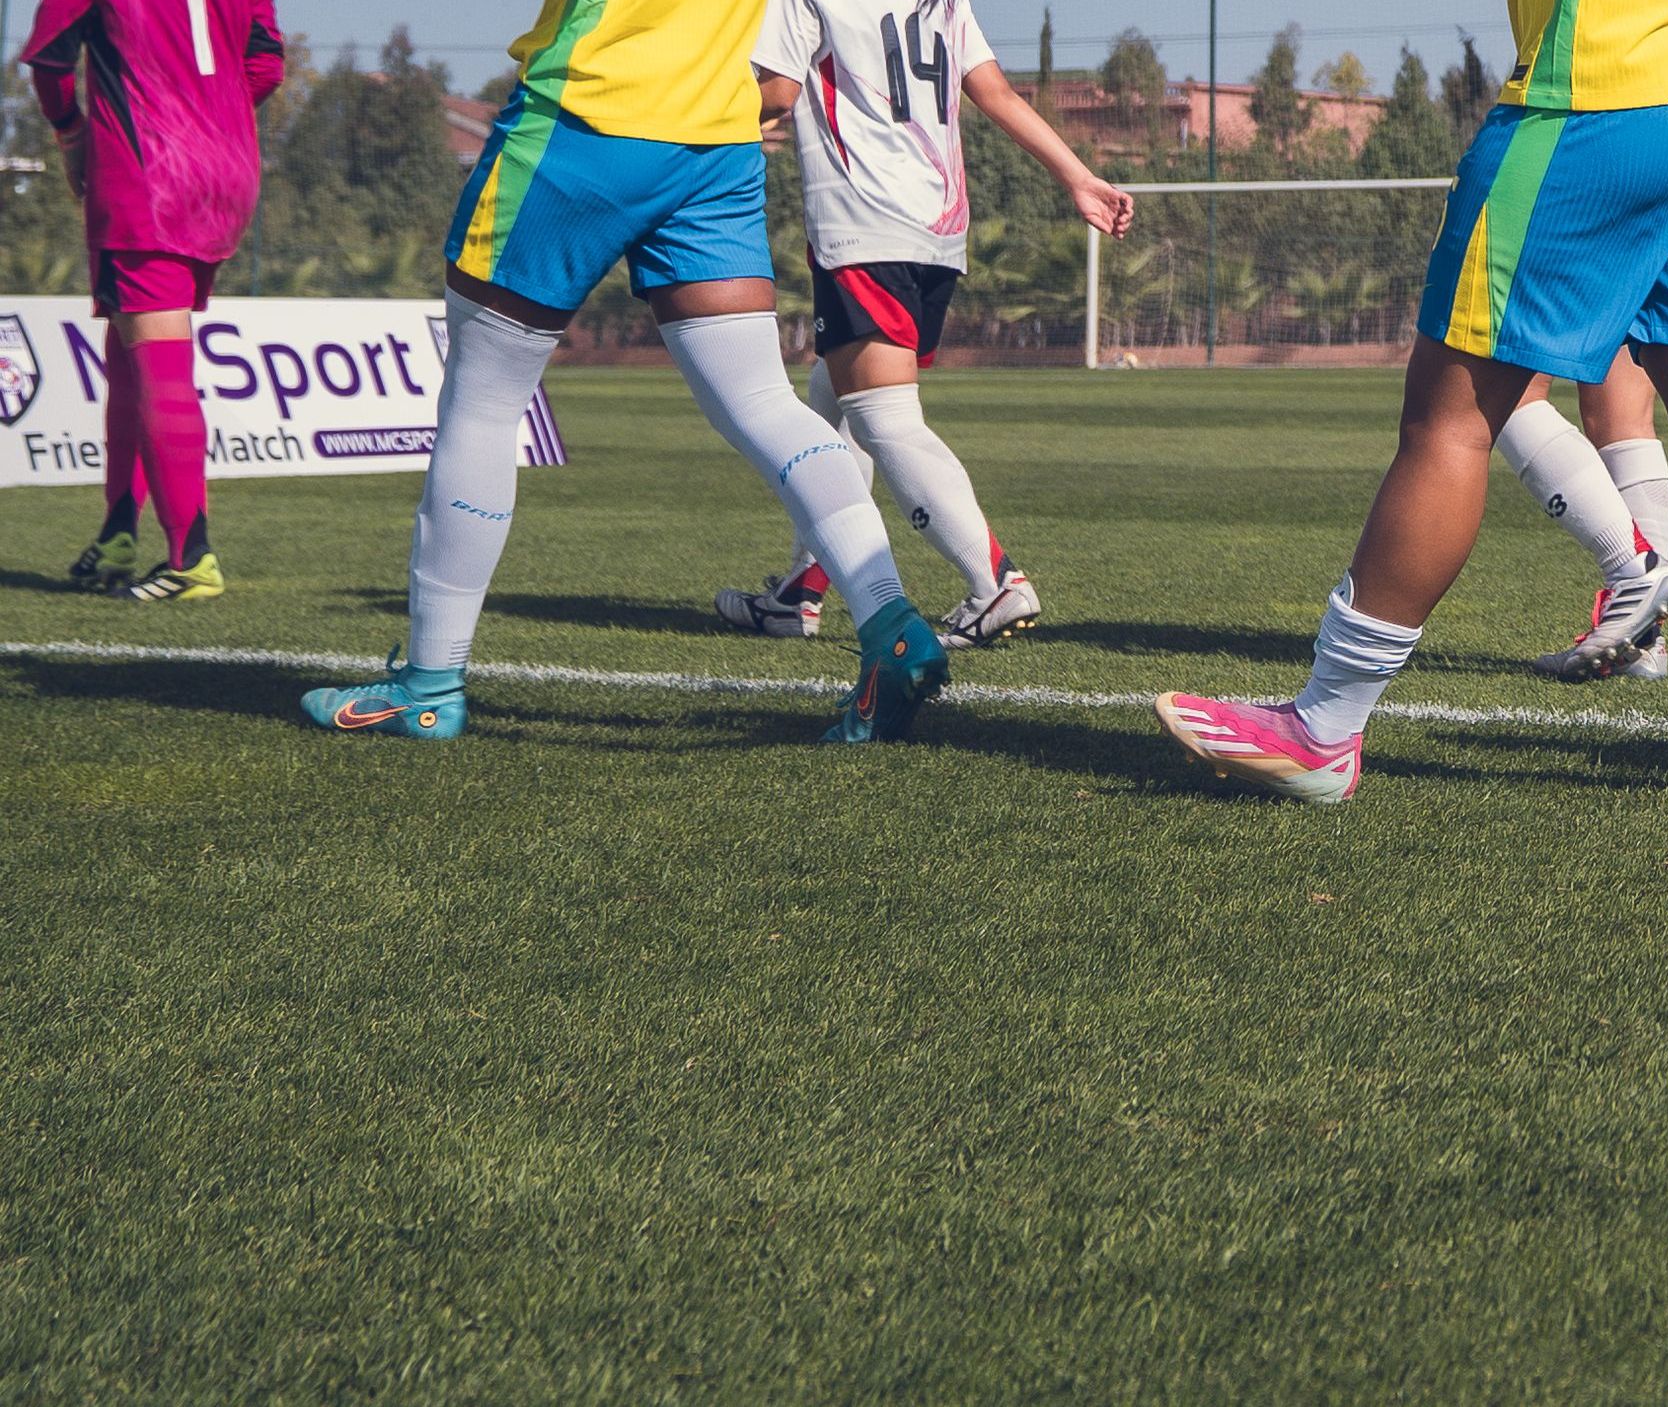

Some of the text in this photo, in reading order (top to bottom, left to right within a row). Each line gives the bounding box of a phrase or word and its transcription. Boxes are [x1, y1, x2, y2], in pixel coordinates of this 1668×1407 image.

[880, 12, 949, 124] 14
[62, 322, 425, 420] Sport
[24, 430, 105, 471] Frie
[450, 499, 513, 521] BRA
